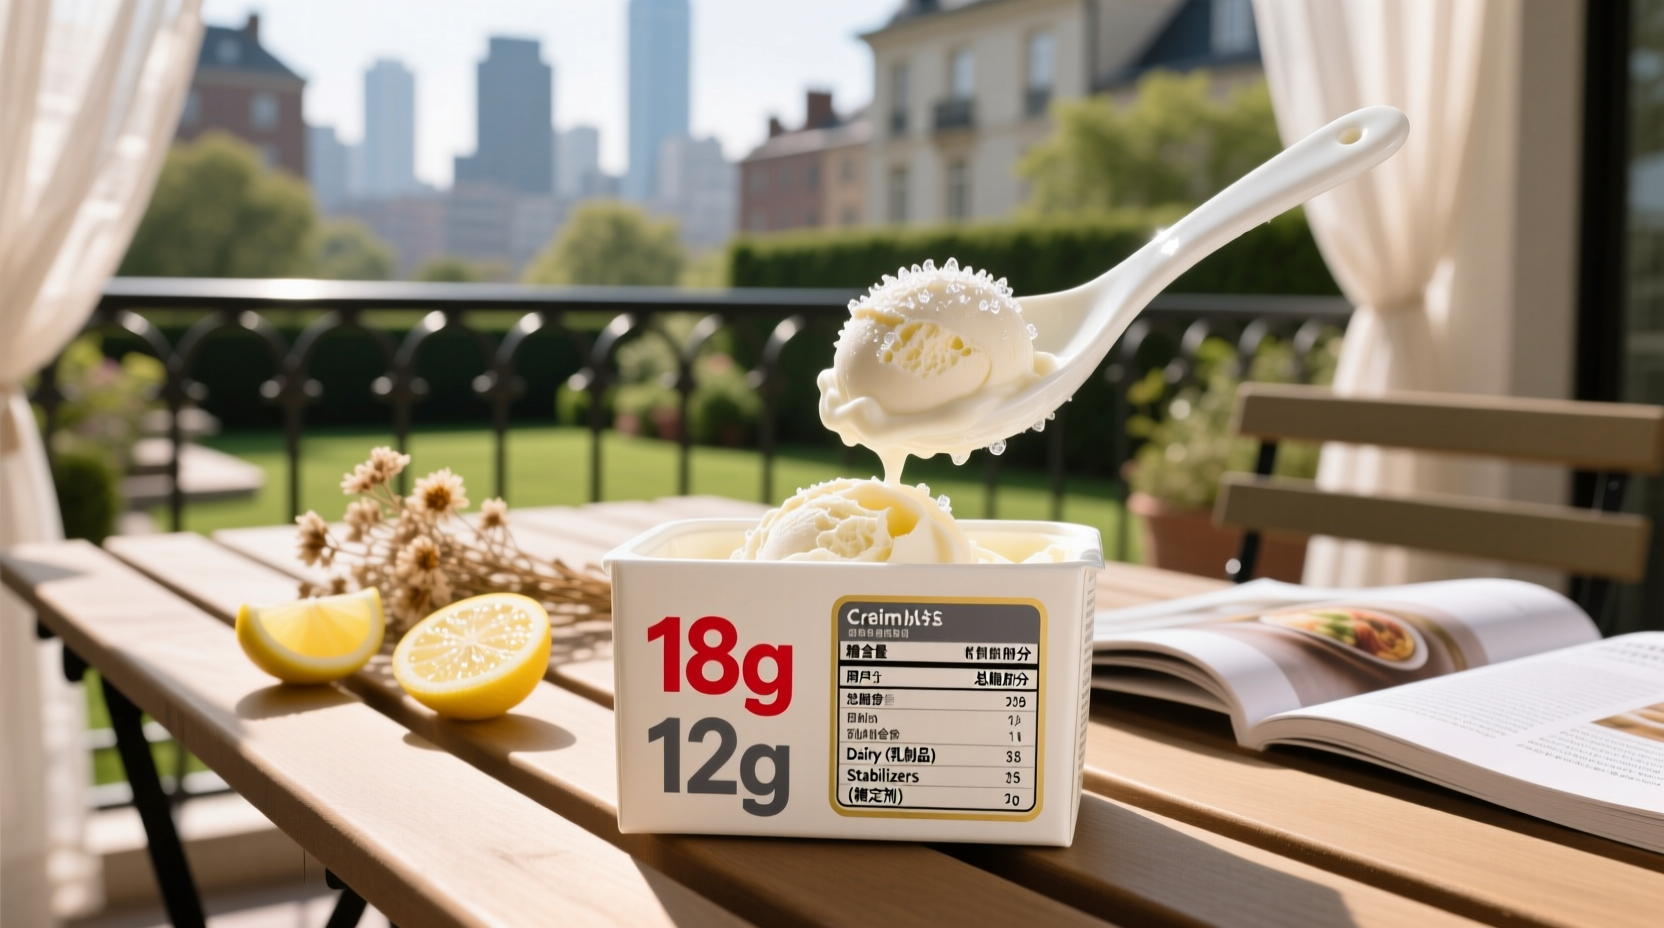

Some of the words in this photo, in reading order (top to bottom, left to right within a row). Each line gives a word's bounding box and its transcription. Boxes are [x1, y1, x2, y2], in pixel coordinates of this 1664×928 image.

[647, 616, 793, 716] 18g
[648, 717, 790, 817] 12g
[847, 747, 882, 765] Dairy
[847, 768, 920, 783] Stabilizers
